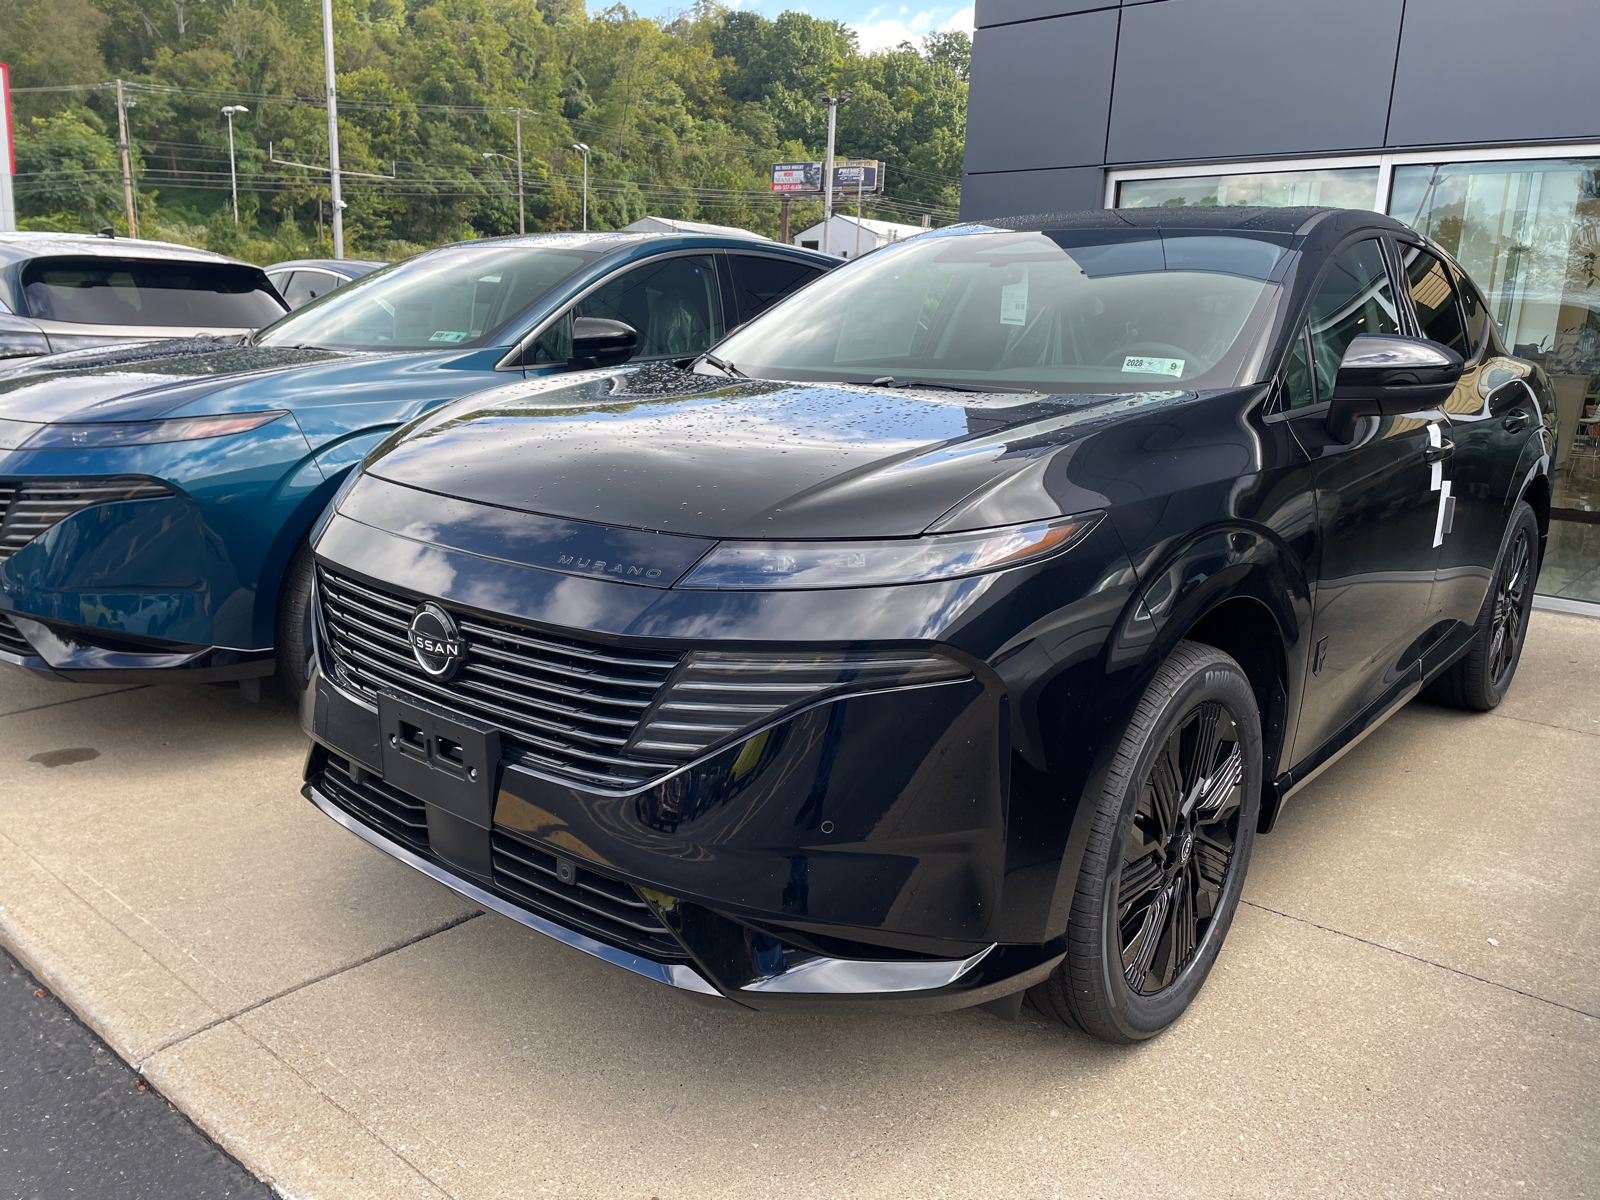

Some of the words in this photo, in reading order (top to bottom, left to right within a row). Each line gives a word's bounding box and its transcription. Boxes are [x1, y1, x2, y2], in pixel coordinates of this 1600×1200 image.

[1126, 359, 1143, 367] 2028
[1170, 362, 1177, 370] 9
[557, 554, 662, 579] MURANO
